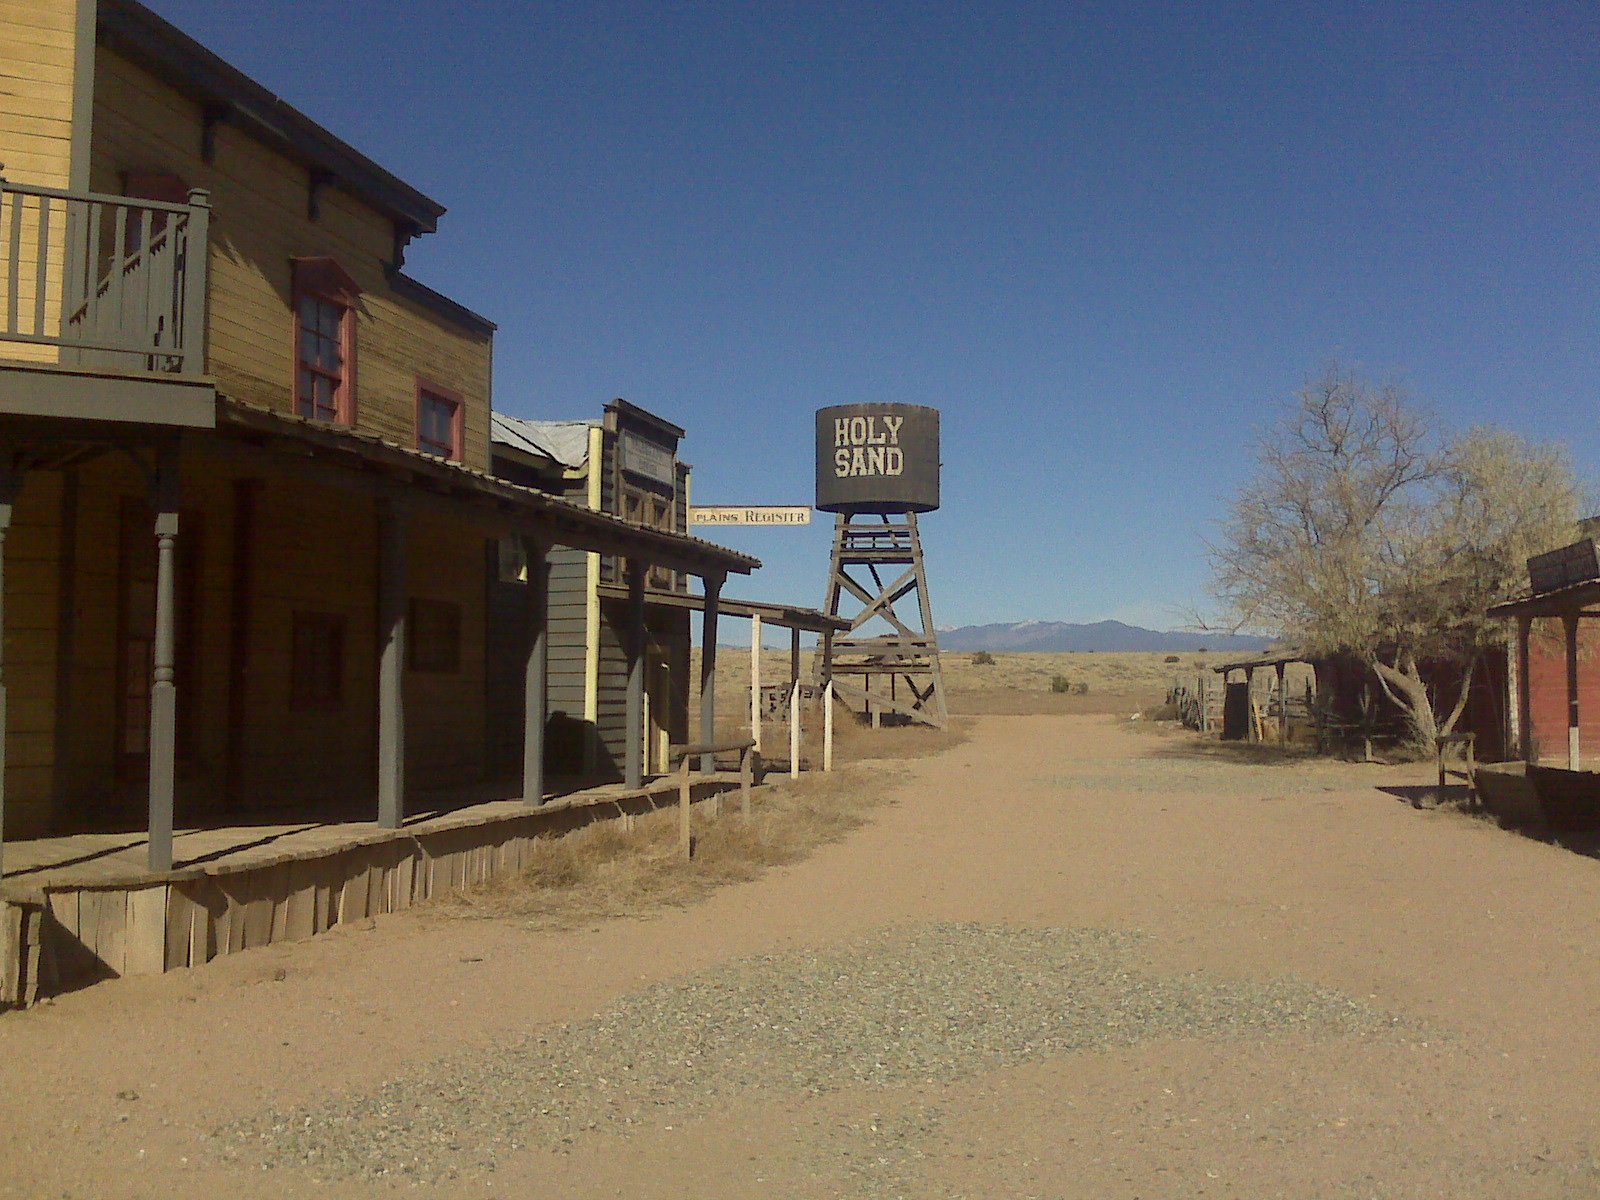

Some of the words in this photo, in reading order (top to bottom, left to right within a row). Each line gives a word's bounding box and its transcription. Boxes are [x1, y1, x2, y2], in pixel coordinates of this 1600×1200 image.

[834, 416, 904, 447] HOLY
[834, 447, 904, 478] SAND
[696, 513, 739, 522] PLAINS
